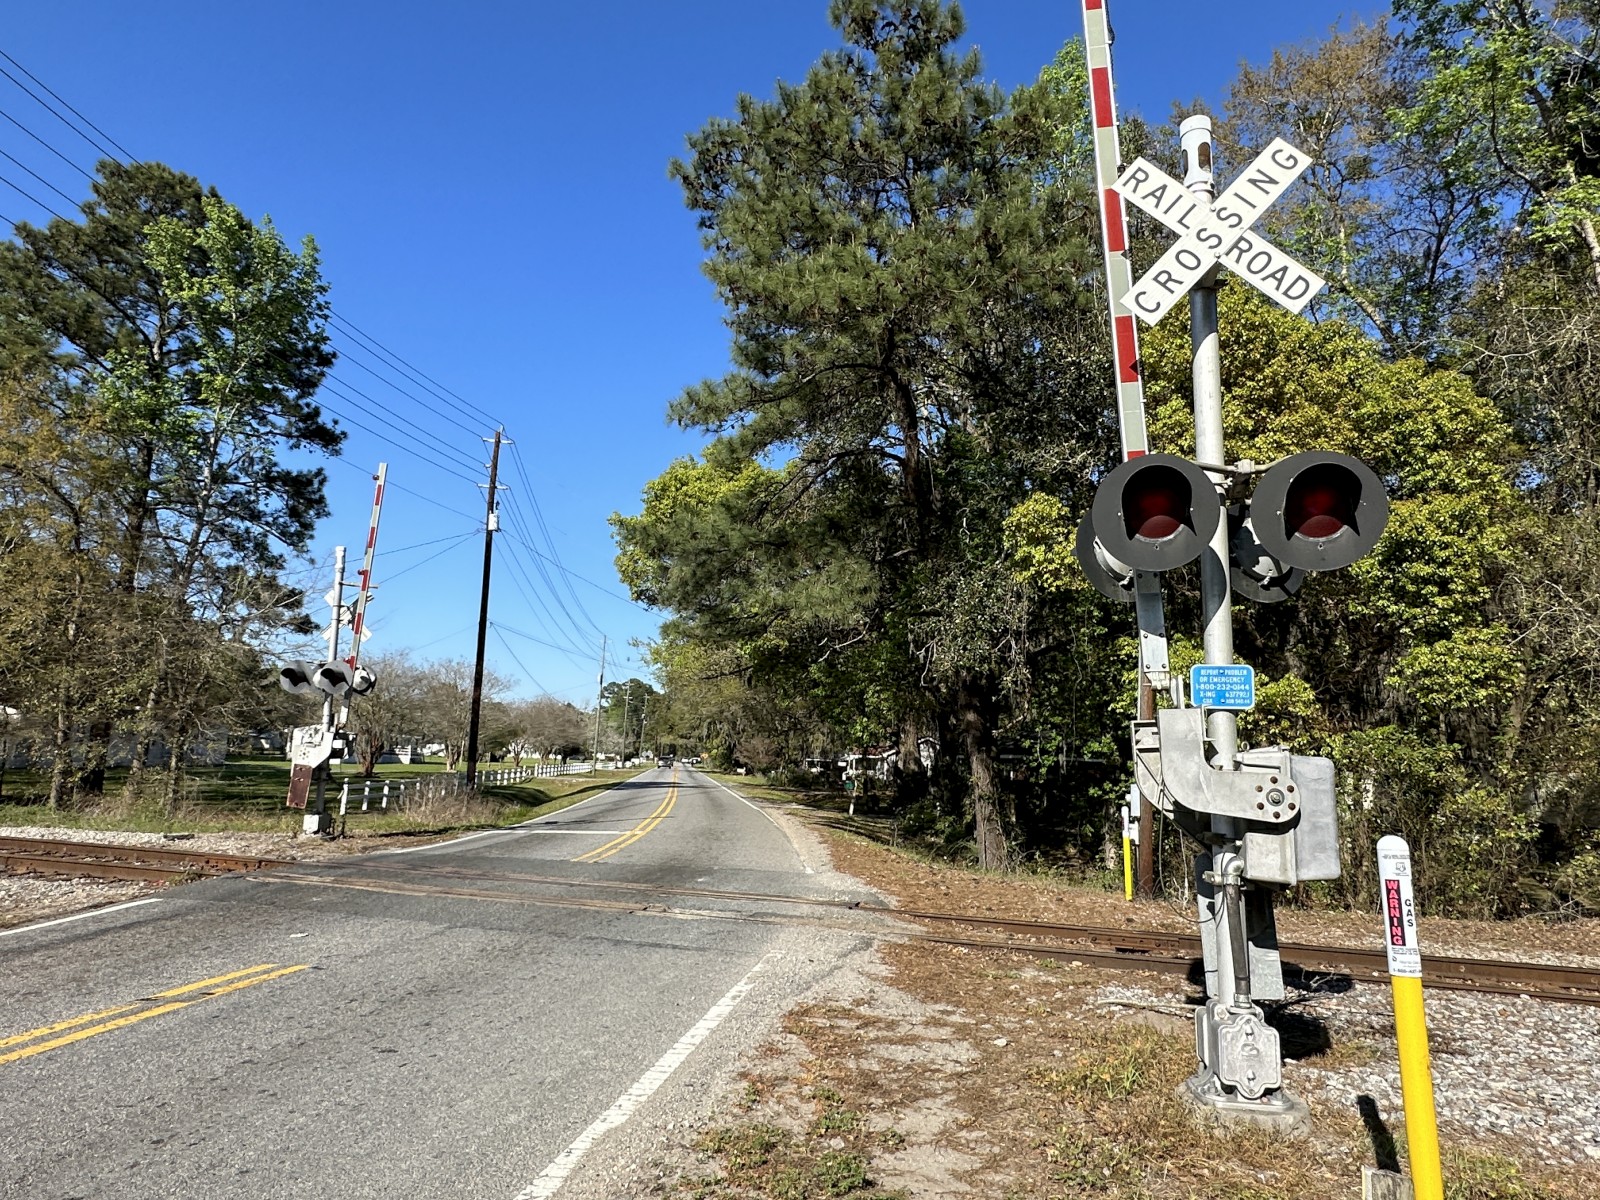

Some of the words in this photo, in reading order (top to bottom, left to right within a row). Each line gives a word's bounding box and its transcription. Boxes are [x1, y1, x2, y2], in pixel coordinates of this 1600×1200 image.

[1122, 166, 1198, 230] RAIL
[1225, 235, 1310, 301] ROAD
[1134, 148, 1299, 314] CROSSING
[1386, 880, 1404, 946] WARNING
[1404, 898, 1414, 928] GAS
